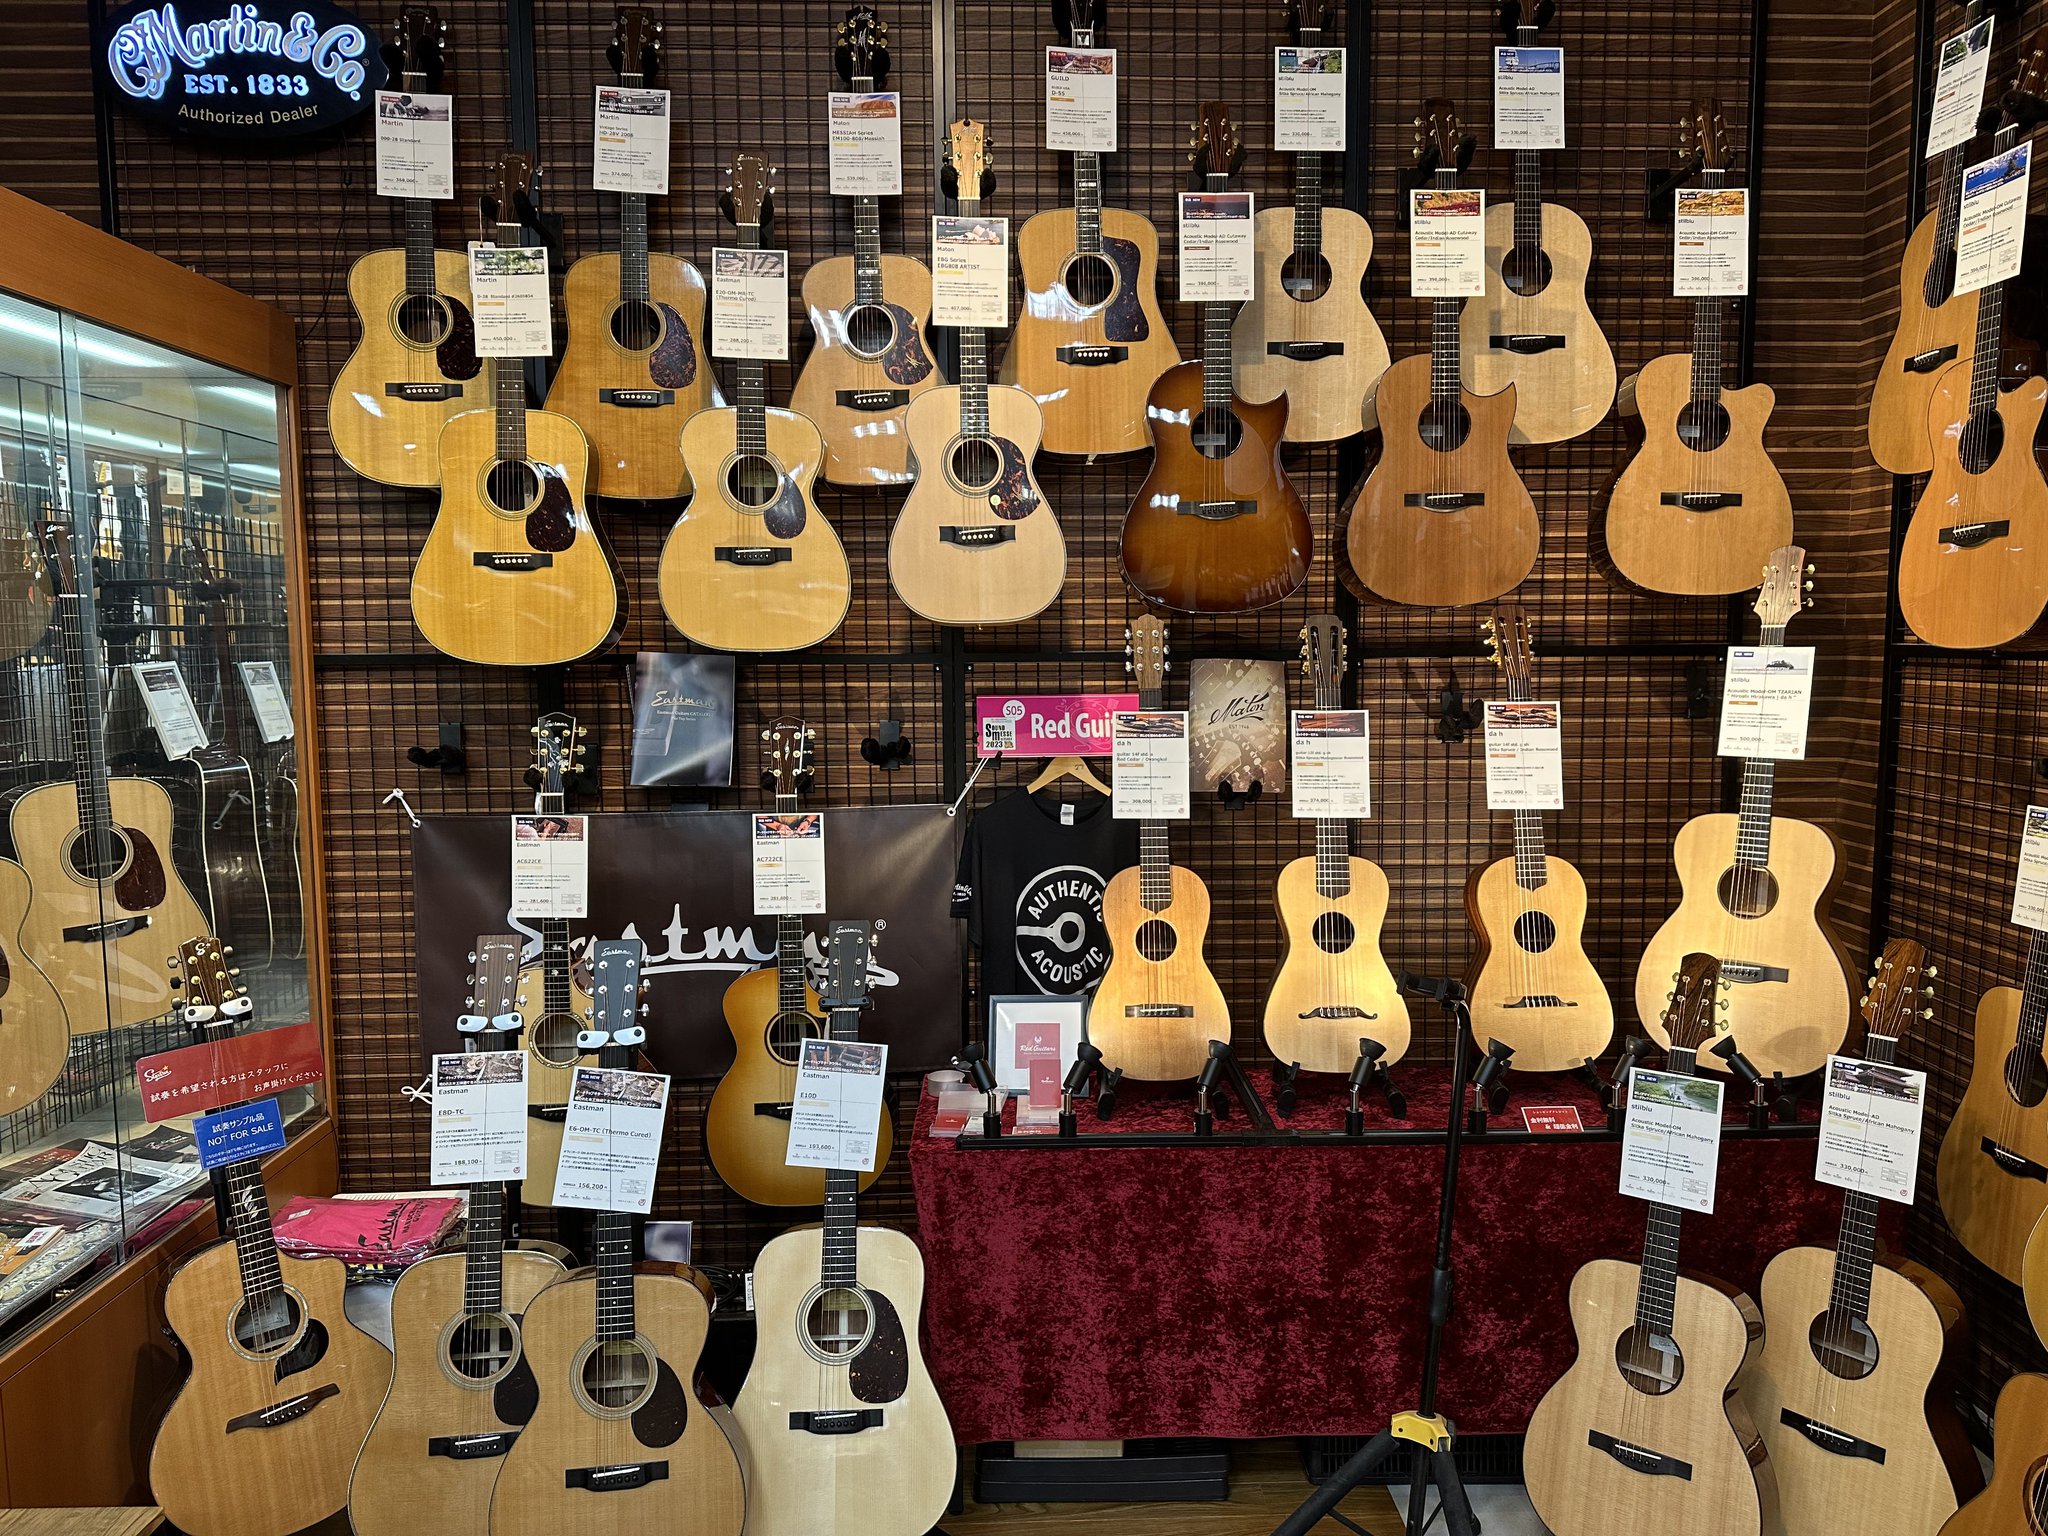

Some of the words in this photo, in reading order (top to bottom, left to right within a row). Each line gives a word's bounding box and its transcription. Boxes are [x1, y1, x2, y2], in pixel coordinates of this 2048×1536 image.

[184, 73, 238, 95] EST.
[247, 73, 310, 97] 1833
[178, 104, 264, 124] Authorized
[271, 105, 319, 123] Dealer
[651, 690, 715, 709] Eastman
[1208, 692, 1270, 725] Maton
[1006, 706, 1023, 715] S05
[1031, 712, 1071, 738] Red
[1075, 713, 1112, 739] Gui
[1031, 946, 1104, 984] ACOUSTIC
[150, 1062, 288, 1103] 試奏を希望される方はスタッフに
[253, 1069, 324, 1093] お声掛けください。
[803, 1072, 830, 1080] Eastman
[1828, 1091, 1850, 1100] stilblu
[573, 1103, 604, 1112] Eastman
[1631, 1104, 1652, 1113] stilblu
[1828, 1105, 1852, 1115] Acoustic
[212, 1113, 265, 1133] 試奏サンプル品
[1631, 1117, 1655, 1126] Acoustic
[1828, 1110, 1842, 1118] Sitka
[1885, 1122, 1914, 1134] Mahogany
[208, 1135, 227, 1147] NOT
[230, 1130, 249, 1141] FOR
[251, 1122, 274, 1135] SALE
[569, 1125, 600, 1134] E6-OM-TC
[602, 1128, 629, 1137] (Thermo
[630, 1129, 652, 1139] Cured)
[1686, 1131, 1714, 1144] Mahogany
[578, 1182, 604, 1190] 156,200
